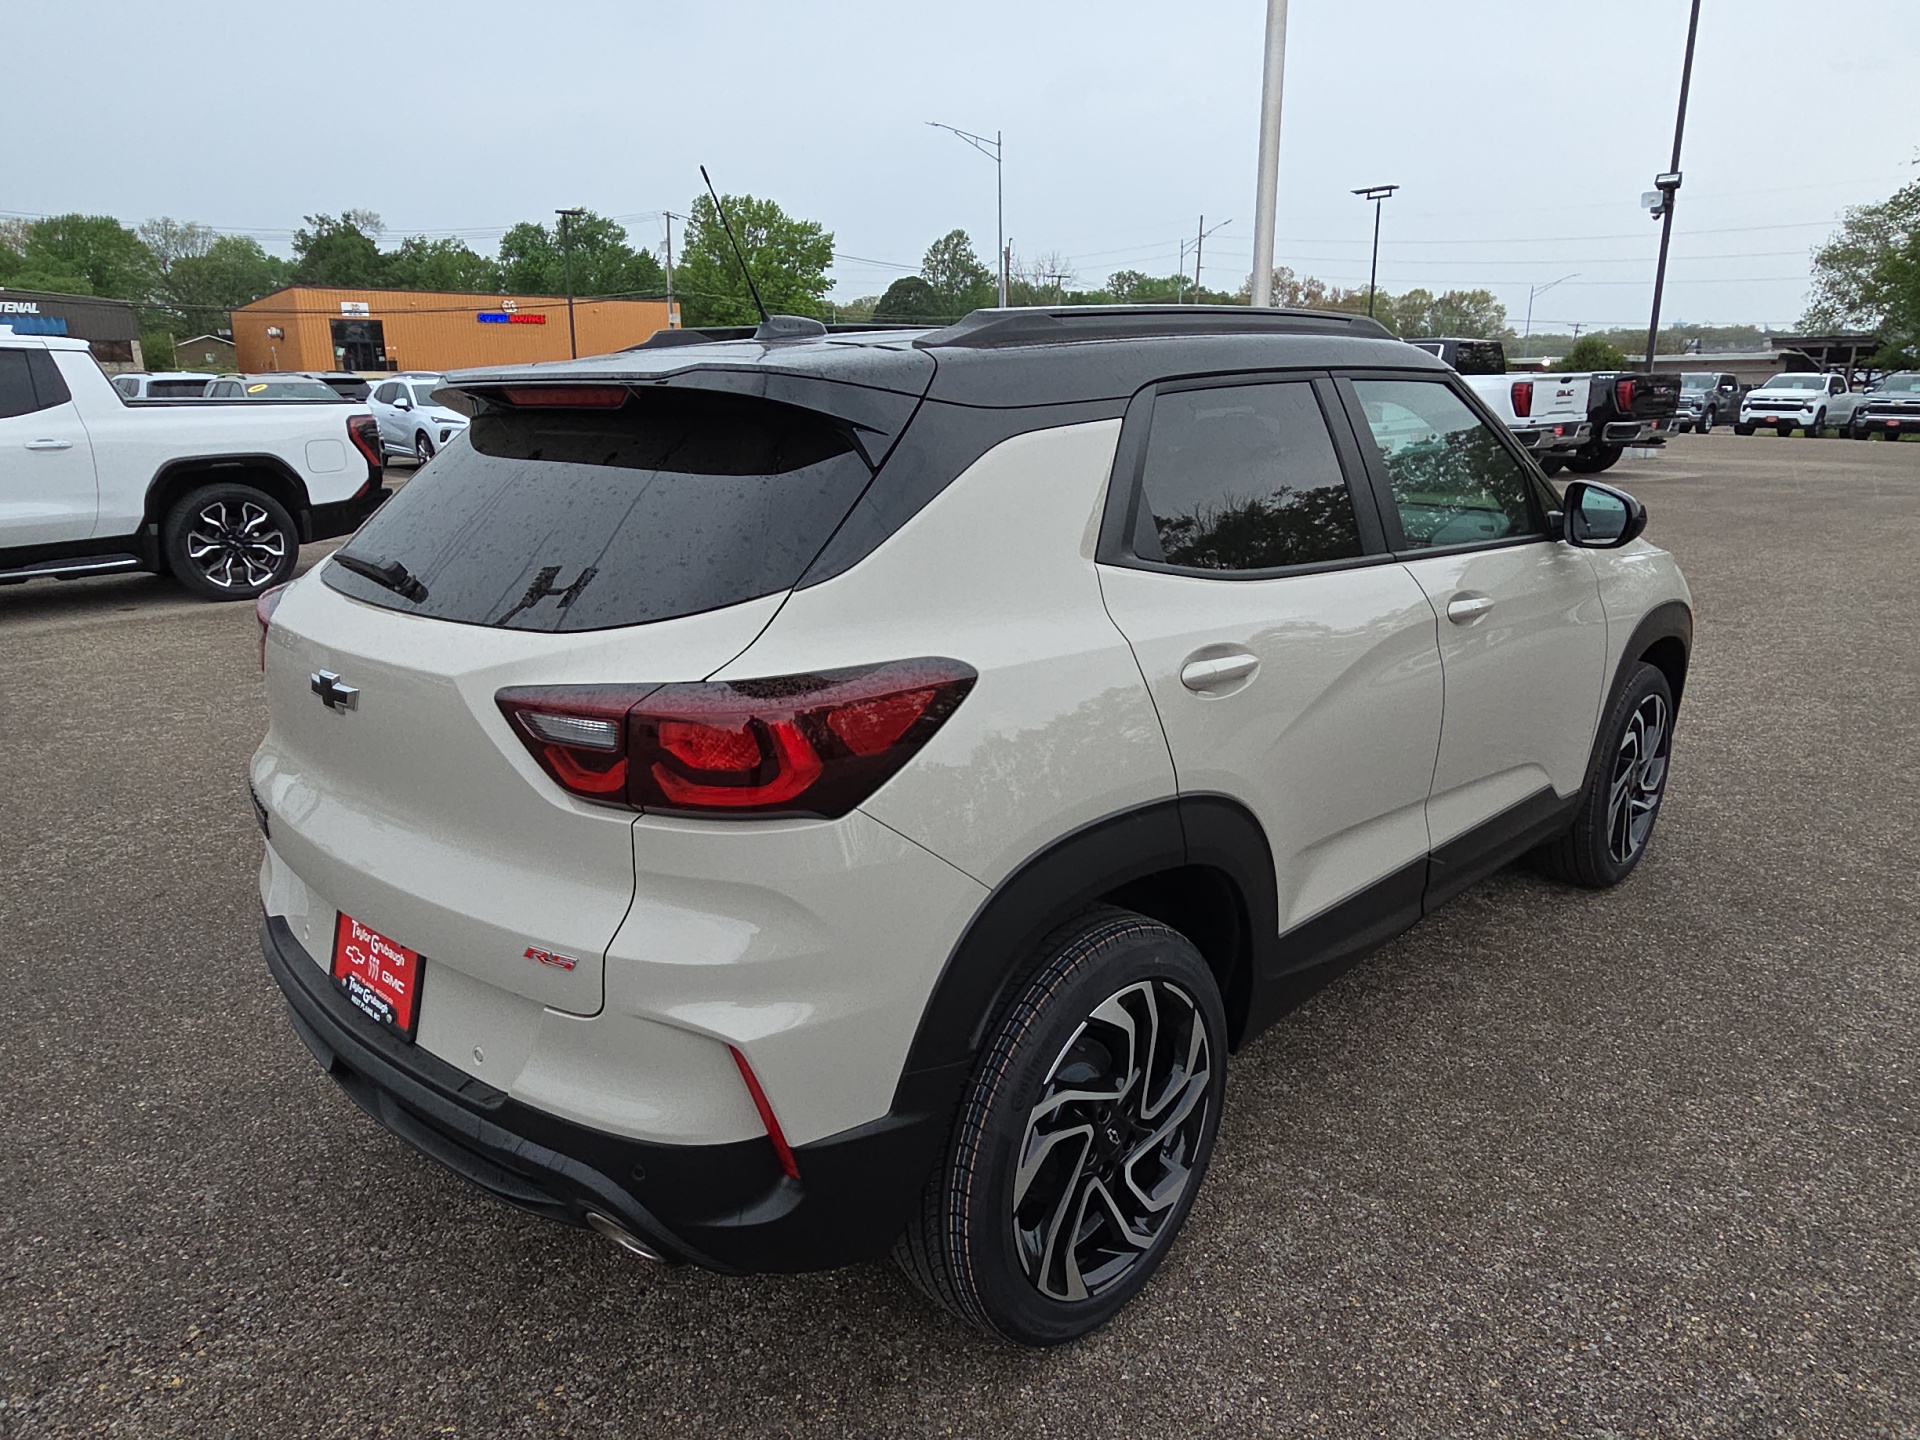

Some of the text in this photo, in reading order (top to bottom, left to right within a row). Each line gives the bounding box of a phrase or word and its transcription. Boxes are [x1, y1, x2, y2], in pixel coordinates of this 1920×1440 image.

[351, 919, 371, 943] Taylor
[523, 945, 579, 971] RS
[381, 970, 405, 995] GMC
